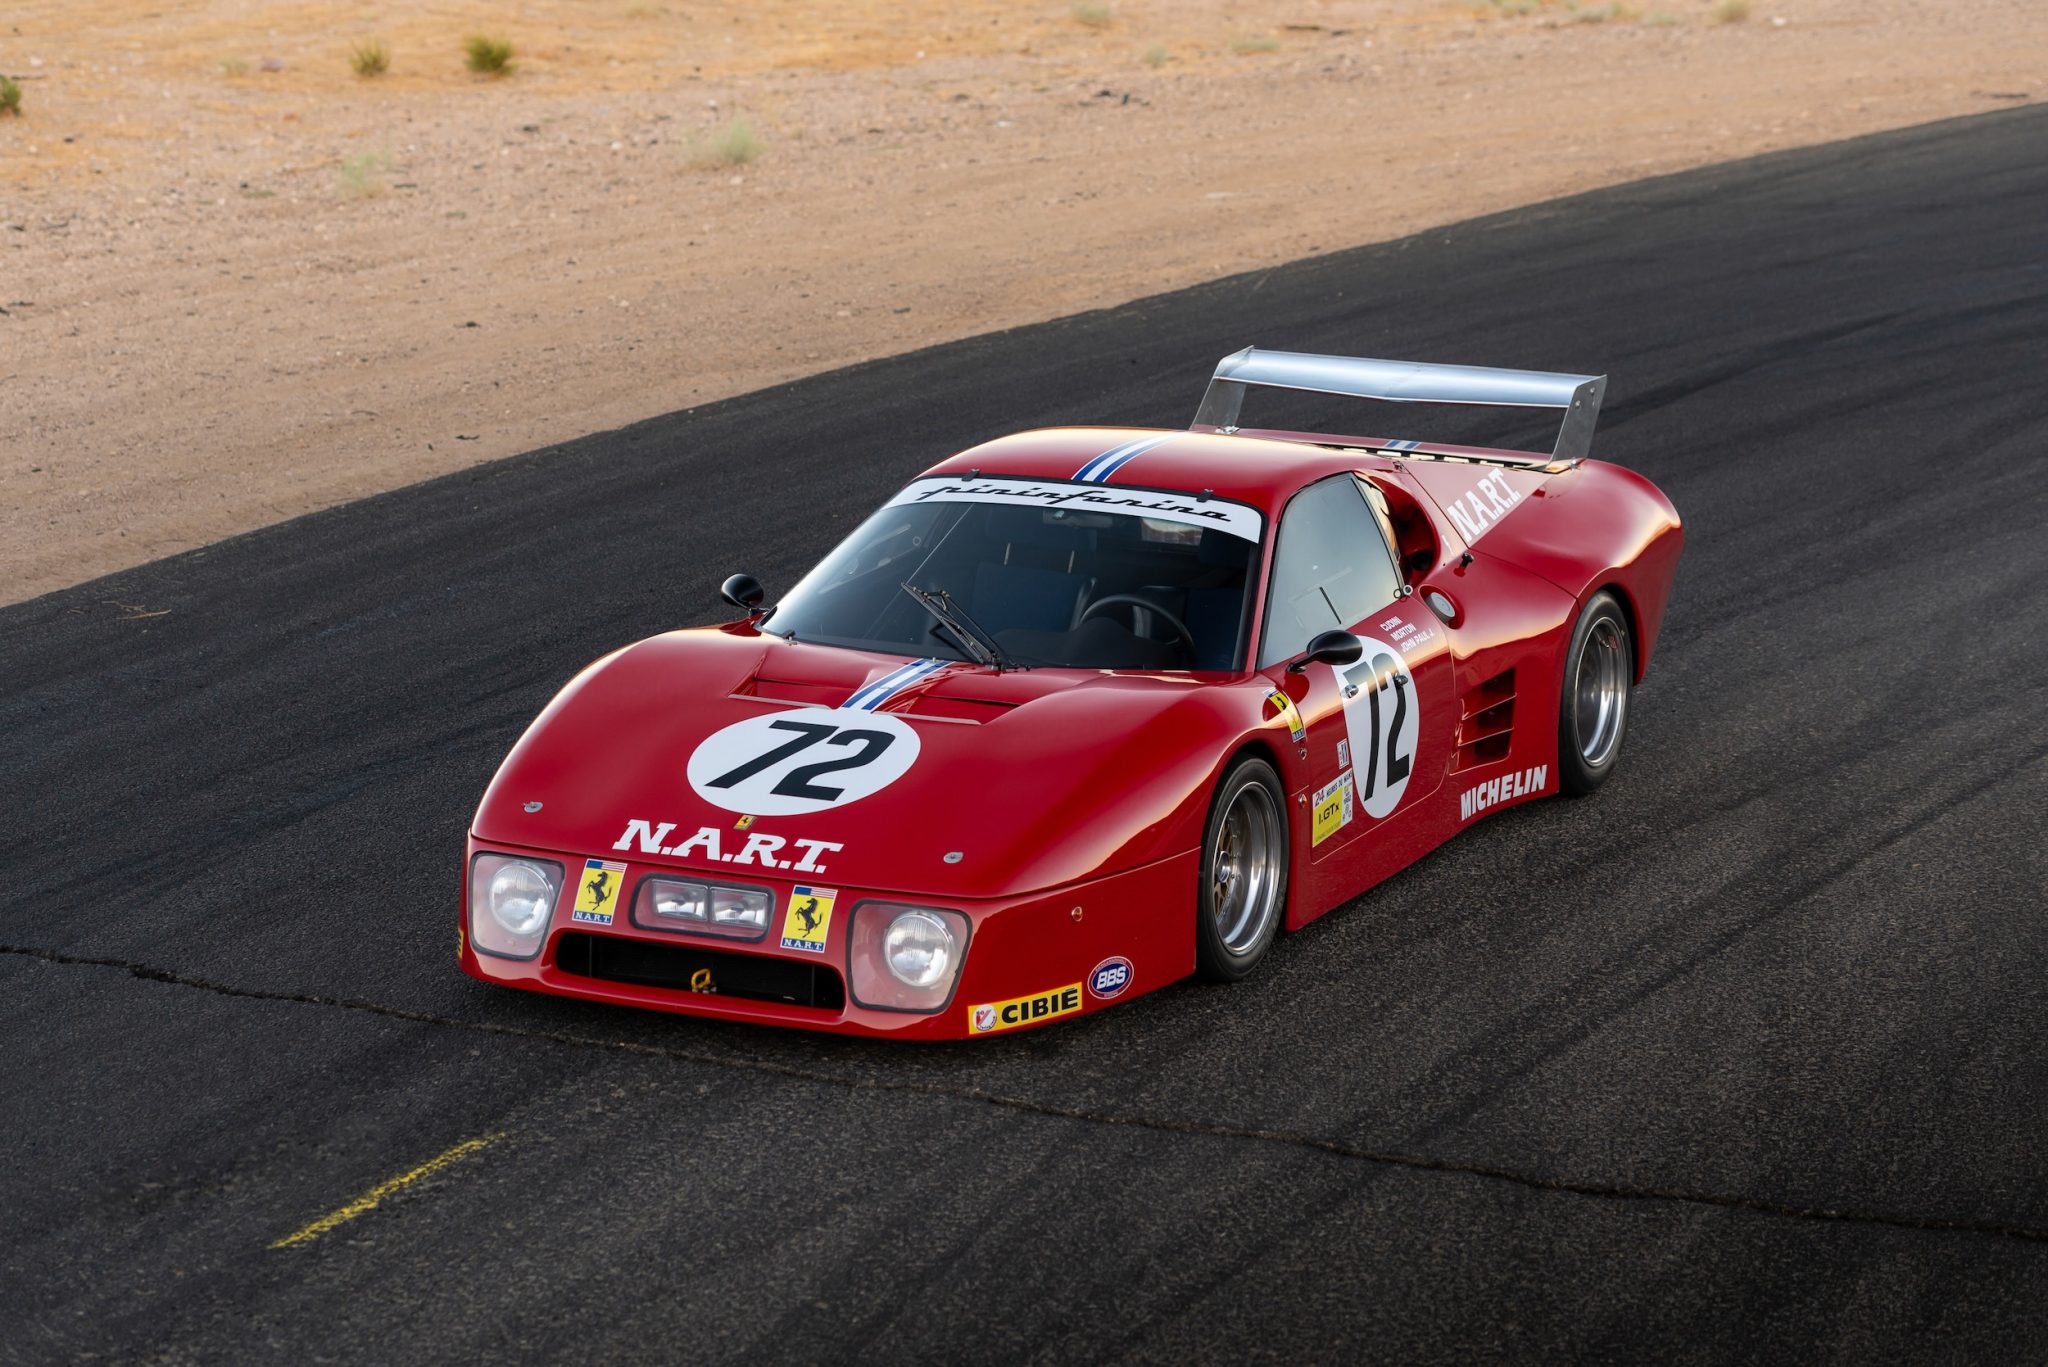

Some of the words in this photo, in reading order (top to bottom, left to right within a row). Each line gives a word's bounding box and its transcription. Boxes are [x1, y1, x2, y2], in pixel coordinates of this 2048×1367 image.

[916, 485, 1232, 522] pininfarina
[1390, 622, 1417, 641] MORTON
[1400, 637, 1417, 653] JOHN
[1413, 631, 1430, 645] PAUL
[1342, 651, 1410, 803] 72
[704, 719, 897, 802] 72
[1314, 789, 1325, 807] 24
[1460, 764, 1548, 822] MICHELIN
[612, 818, 845, 875] N.A.R.T.
[1096, 966, 1127, 990] BBS
